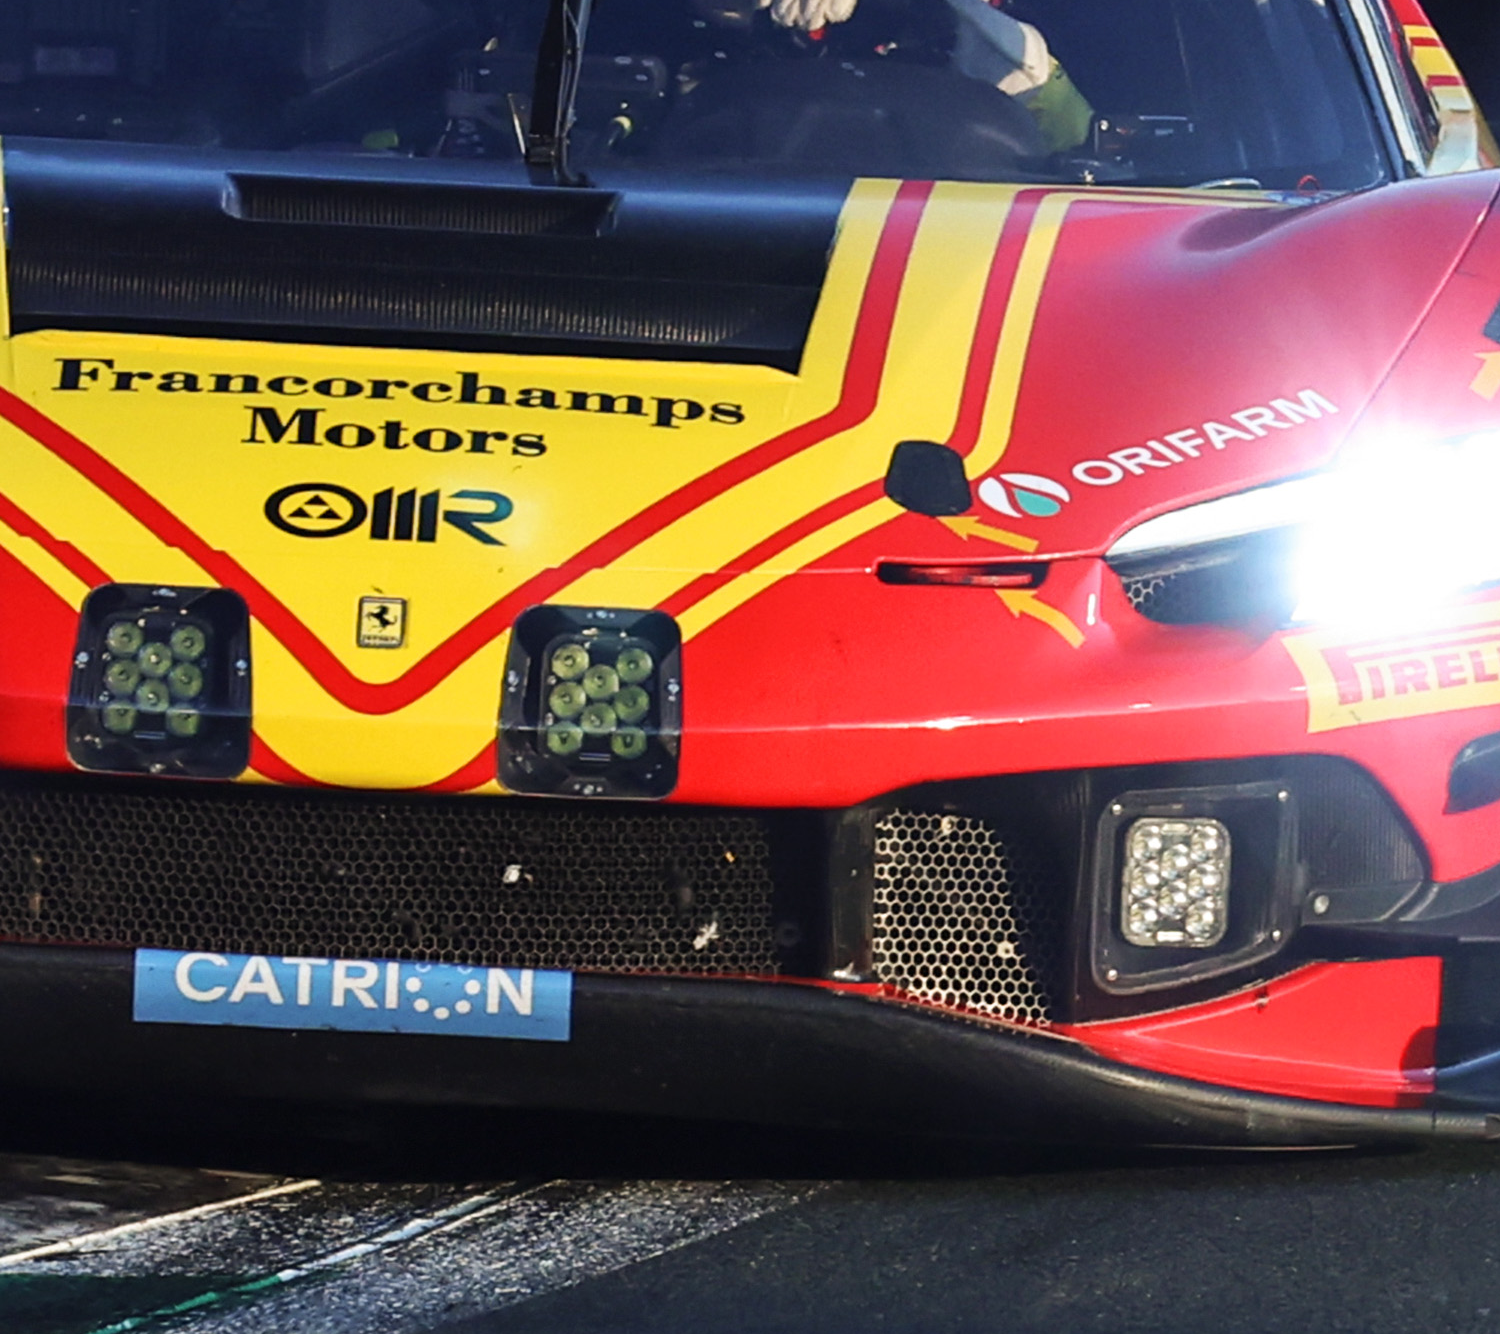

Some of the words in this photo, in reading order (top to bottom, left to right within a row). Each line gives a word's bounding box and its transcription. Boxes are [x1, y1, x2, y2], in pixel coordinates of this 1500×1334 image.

[51, 357, 747, 430] Francorchamps
[240, 406, 550, 460] Motors
[1070, 388, 1340, 487] ORIFARM
[173, 953, 535, 1022] CATRION
